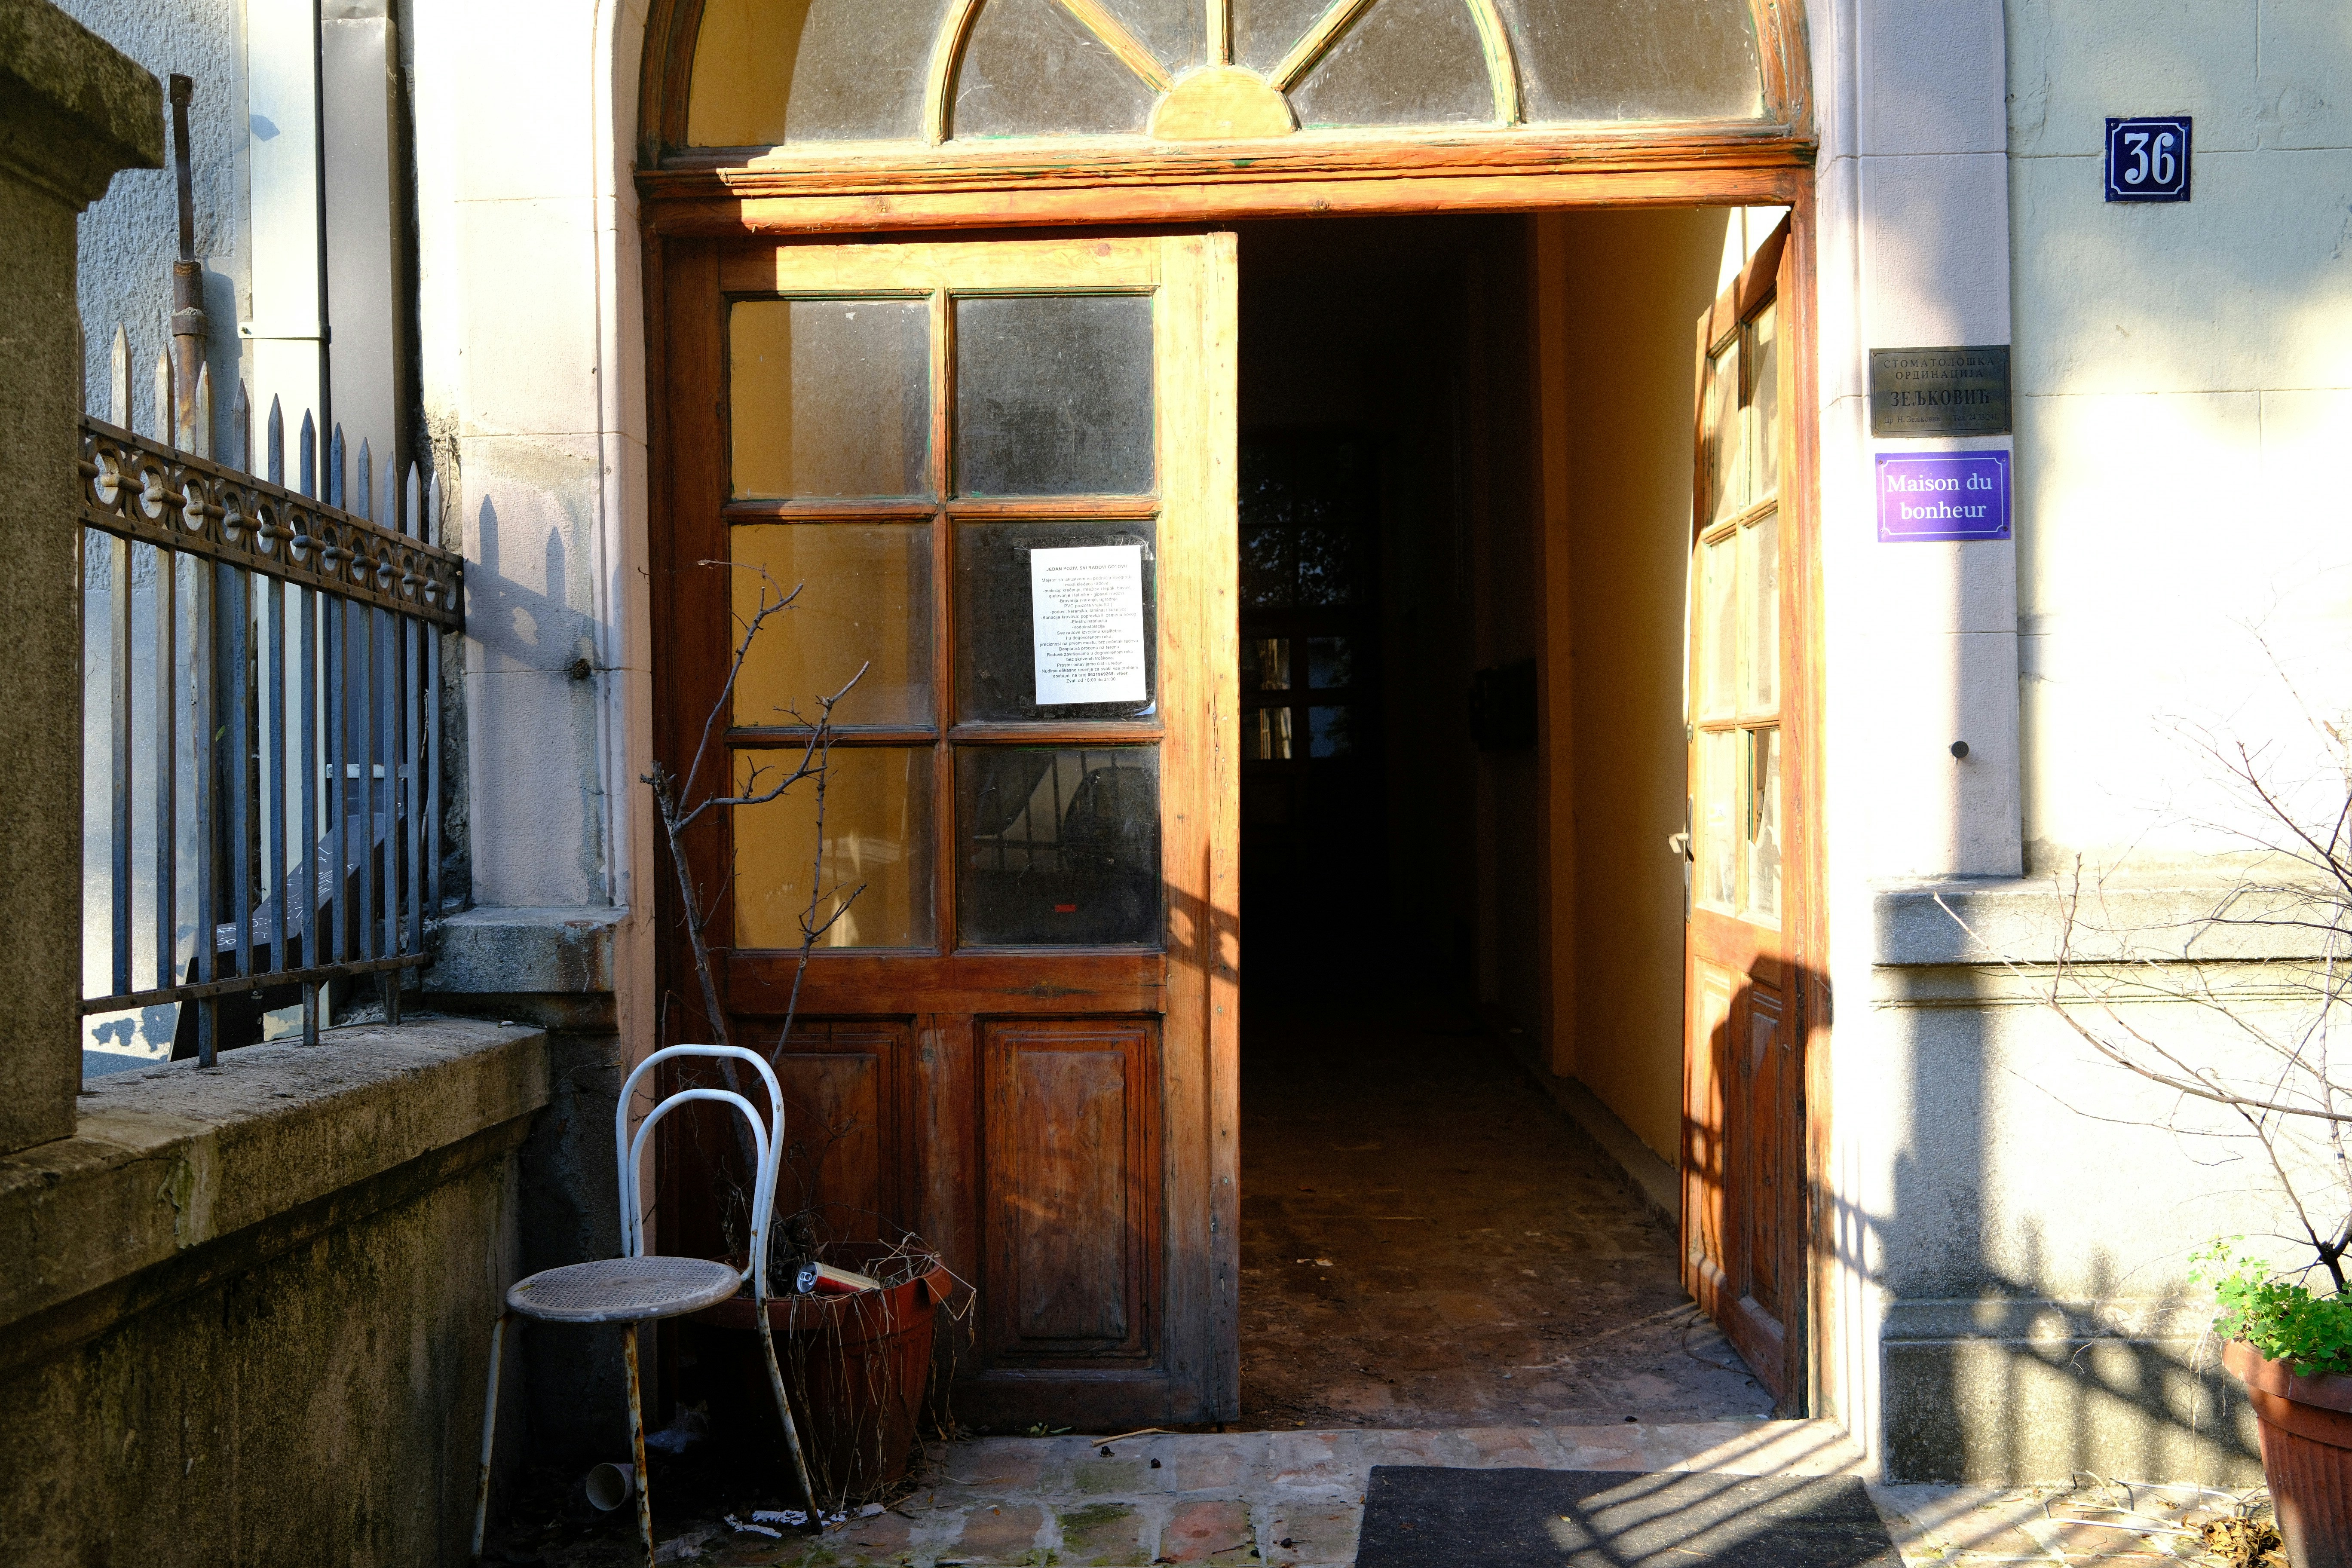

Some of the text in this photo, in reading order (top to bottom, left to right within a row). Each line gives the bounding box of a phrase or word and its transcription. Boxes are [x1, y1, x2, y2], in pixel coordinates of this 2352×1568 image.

[2124, 132, 2175, 184] 36
[1884, 357, 1995, 368] СТОМАТОЛОШКА
[1896, 370, 1984, 380] ОРДИНАЦИЈА
[1890, 389, 1990, 407] ЗЕЉКОВИЋ
[1884, 416, 1894, 424] Др
[1907, 414, 1941, 423] Зељковић
[1886, 473, 1993, 492] Maison du
[1899, 501, 1987, 520] bonheur
